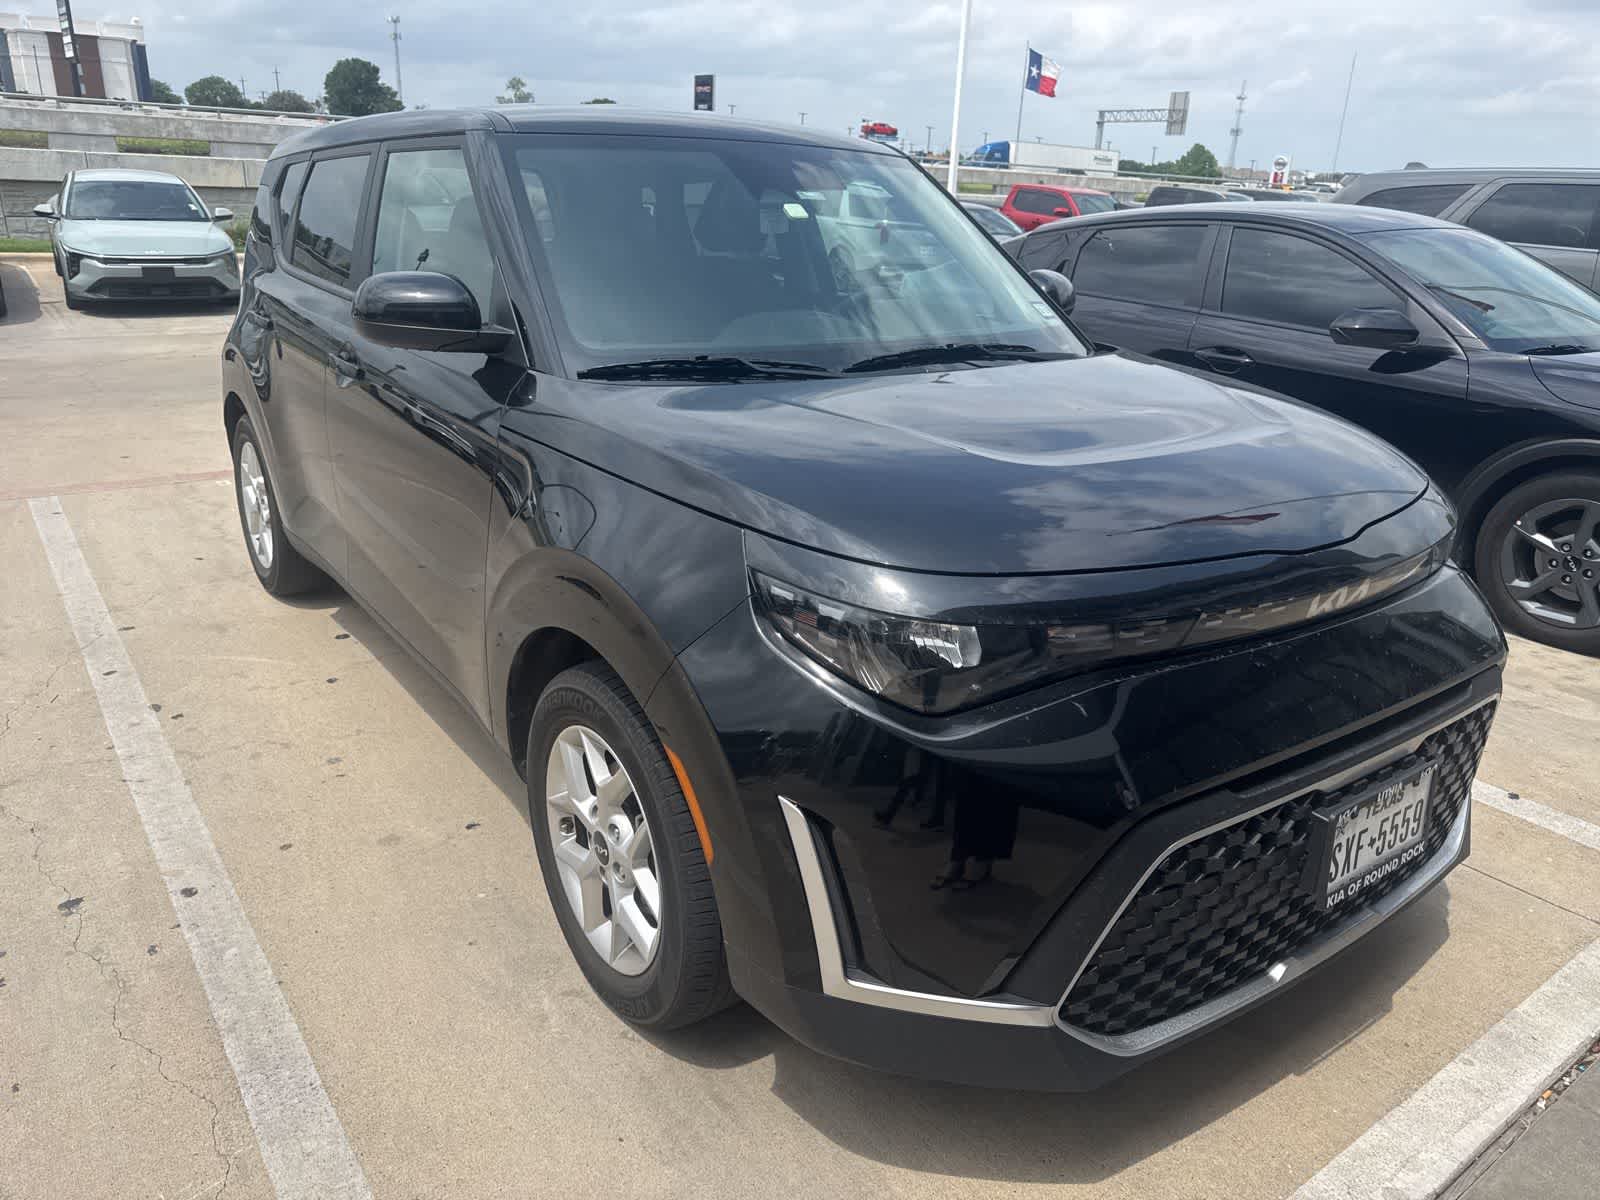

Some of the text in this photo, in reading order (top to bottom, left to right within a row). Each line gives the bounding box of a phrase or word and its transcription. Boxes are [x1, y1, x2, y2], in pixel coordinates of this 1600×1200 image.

[1366, 790, 1405, 819] TEXAS
[1326, 841, 1425, 909] KIA OF ROUND ROCK
